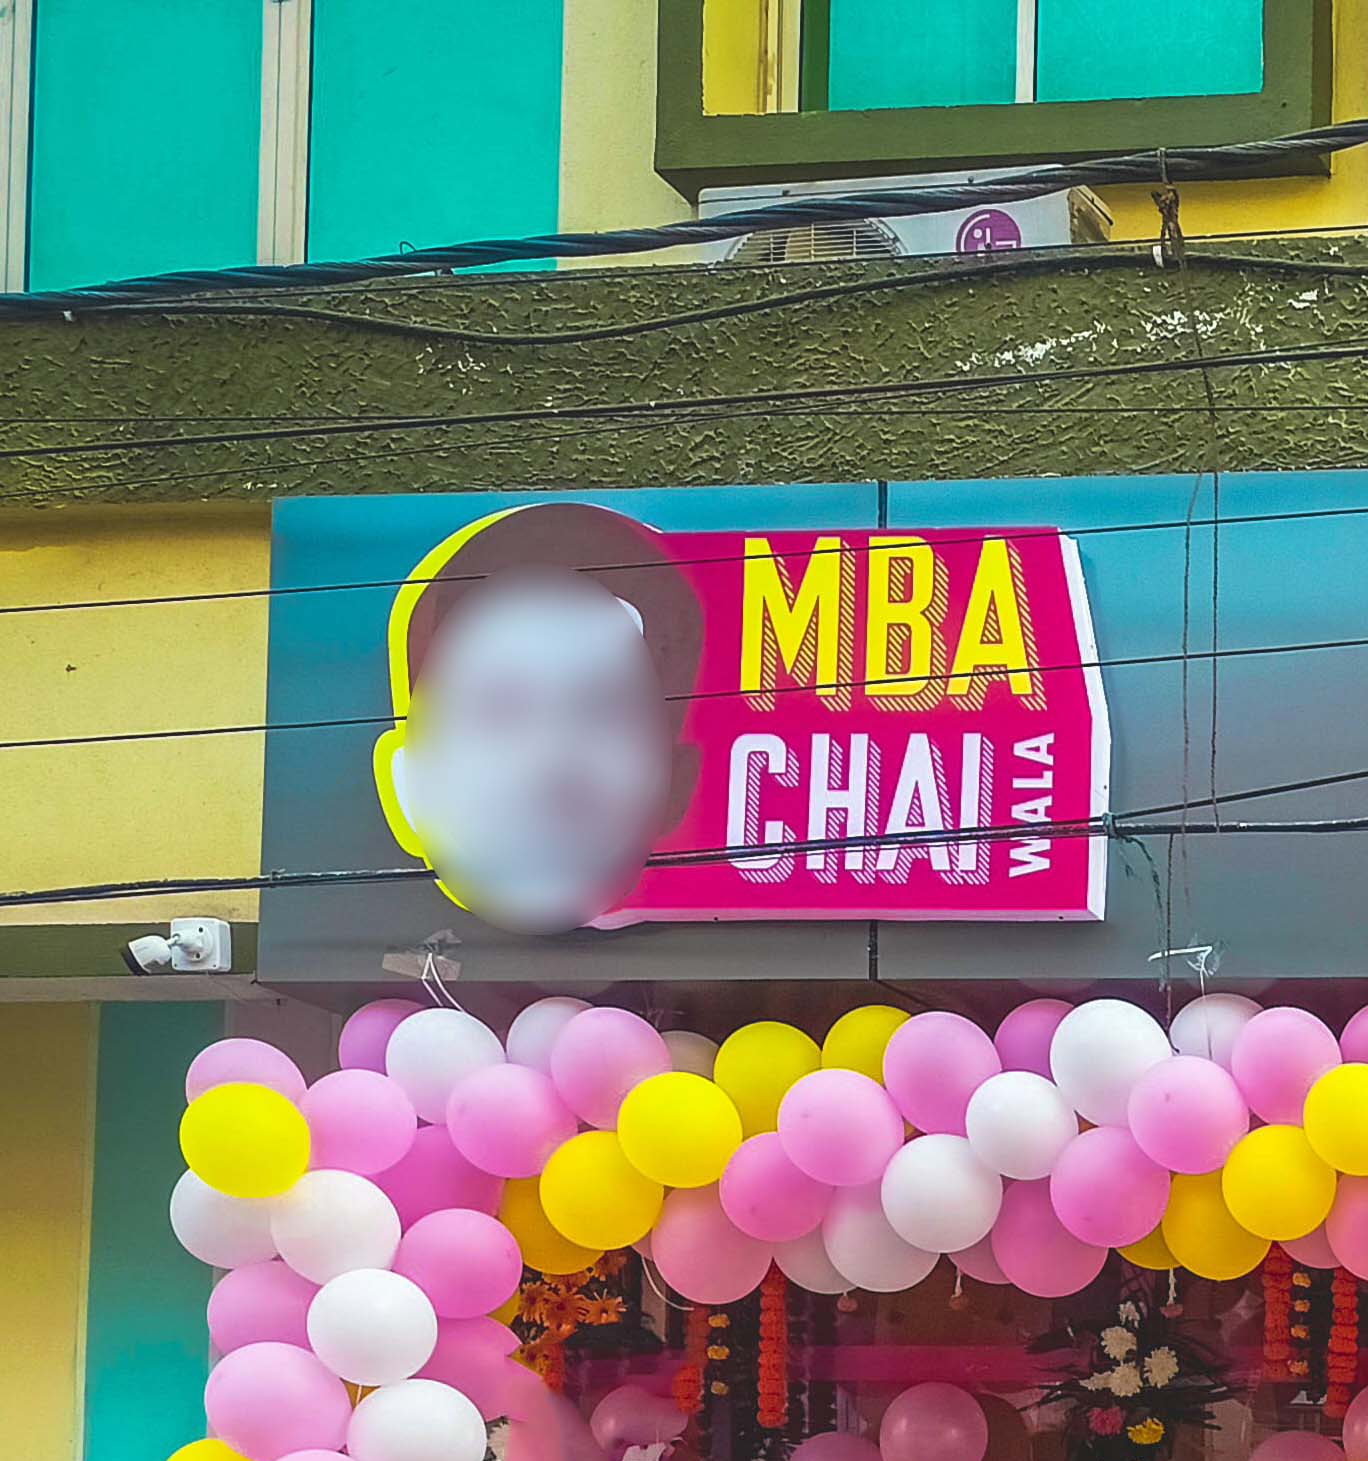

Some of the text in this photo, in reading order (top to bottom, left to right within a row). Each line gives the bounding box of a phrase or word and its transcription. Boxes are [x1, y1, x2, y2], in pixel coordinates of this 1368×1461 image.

[738, 536, 1047, 712] MBA
[726, 732, 994, 885] CHAI
[1008, 731, 1056, 879] WALA
